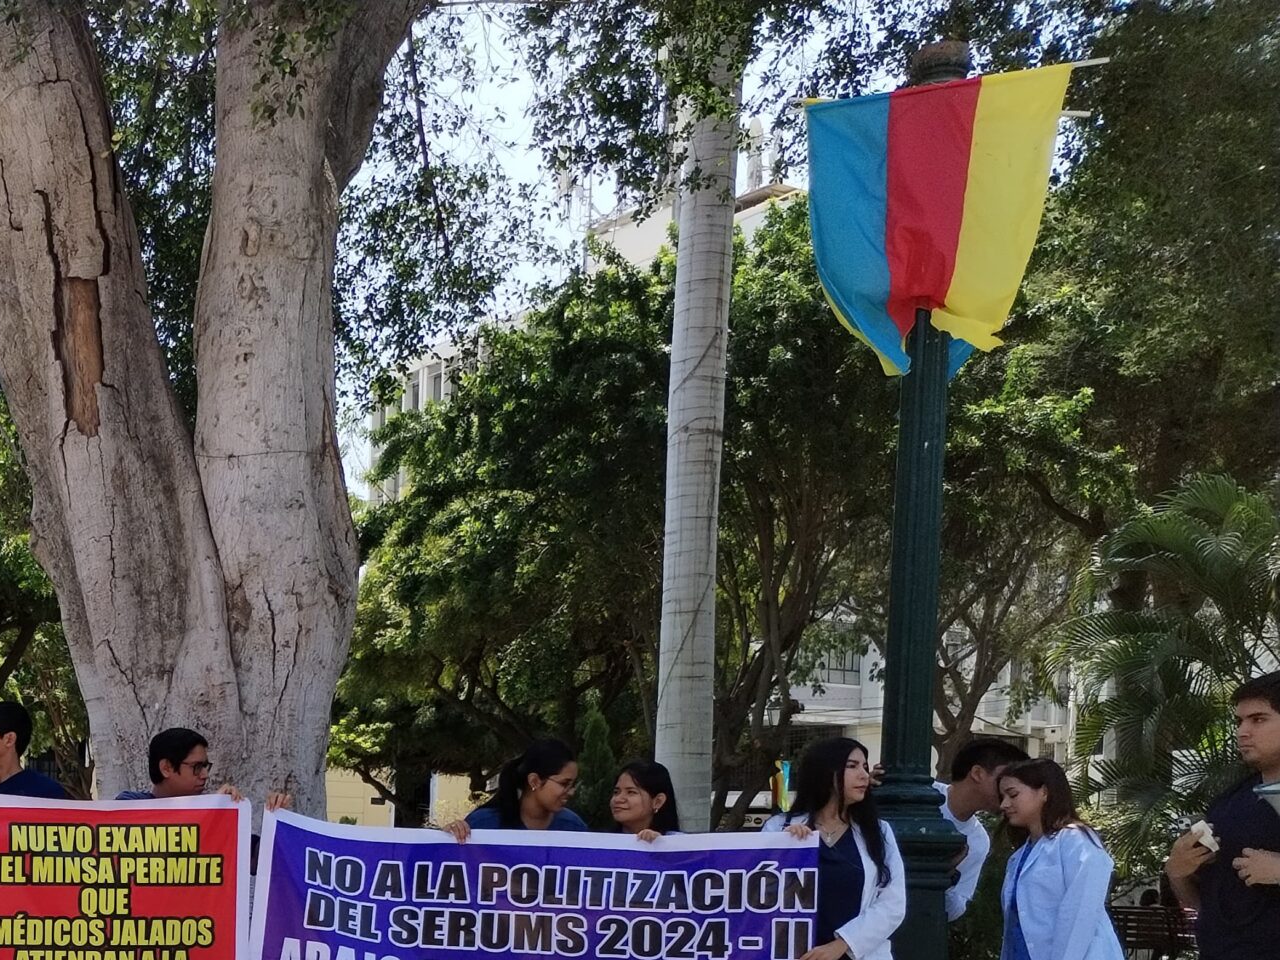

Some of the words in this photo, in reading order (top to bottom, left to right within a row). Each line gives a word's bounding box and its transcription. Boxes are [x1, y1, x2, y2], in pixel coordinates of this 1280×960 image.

[10, 825, 94, 853] NUEVO
[98, 826, 198, 853] EXAMEN
[32, 856, 115, 884] MINSA
[120, 856, 222, 884] PERMITE
[305, 847, 365, 896] NO
[370, 860, 406, 901] A
[412, 861, 470, 903] LA
[477, 860, 818, 914] POLITIZACIÓN
[80, 887, 129, 916] QUE
[110, 918, 213, 946] JALADOS
[304, 888, 381, 943] DEL
[388, 905, 587, 957] SERUMS
[596, 915, 732, 960] 2024
